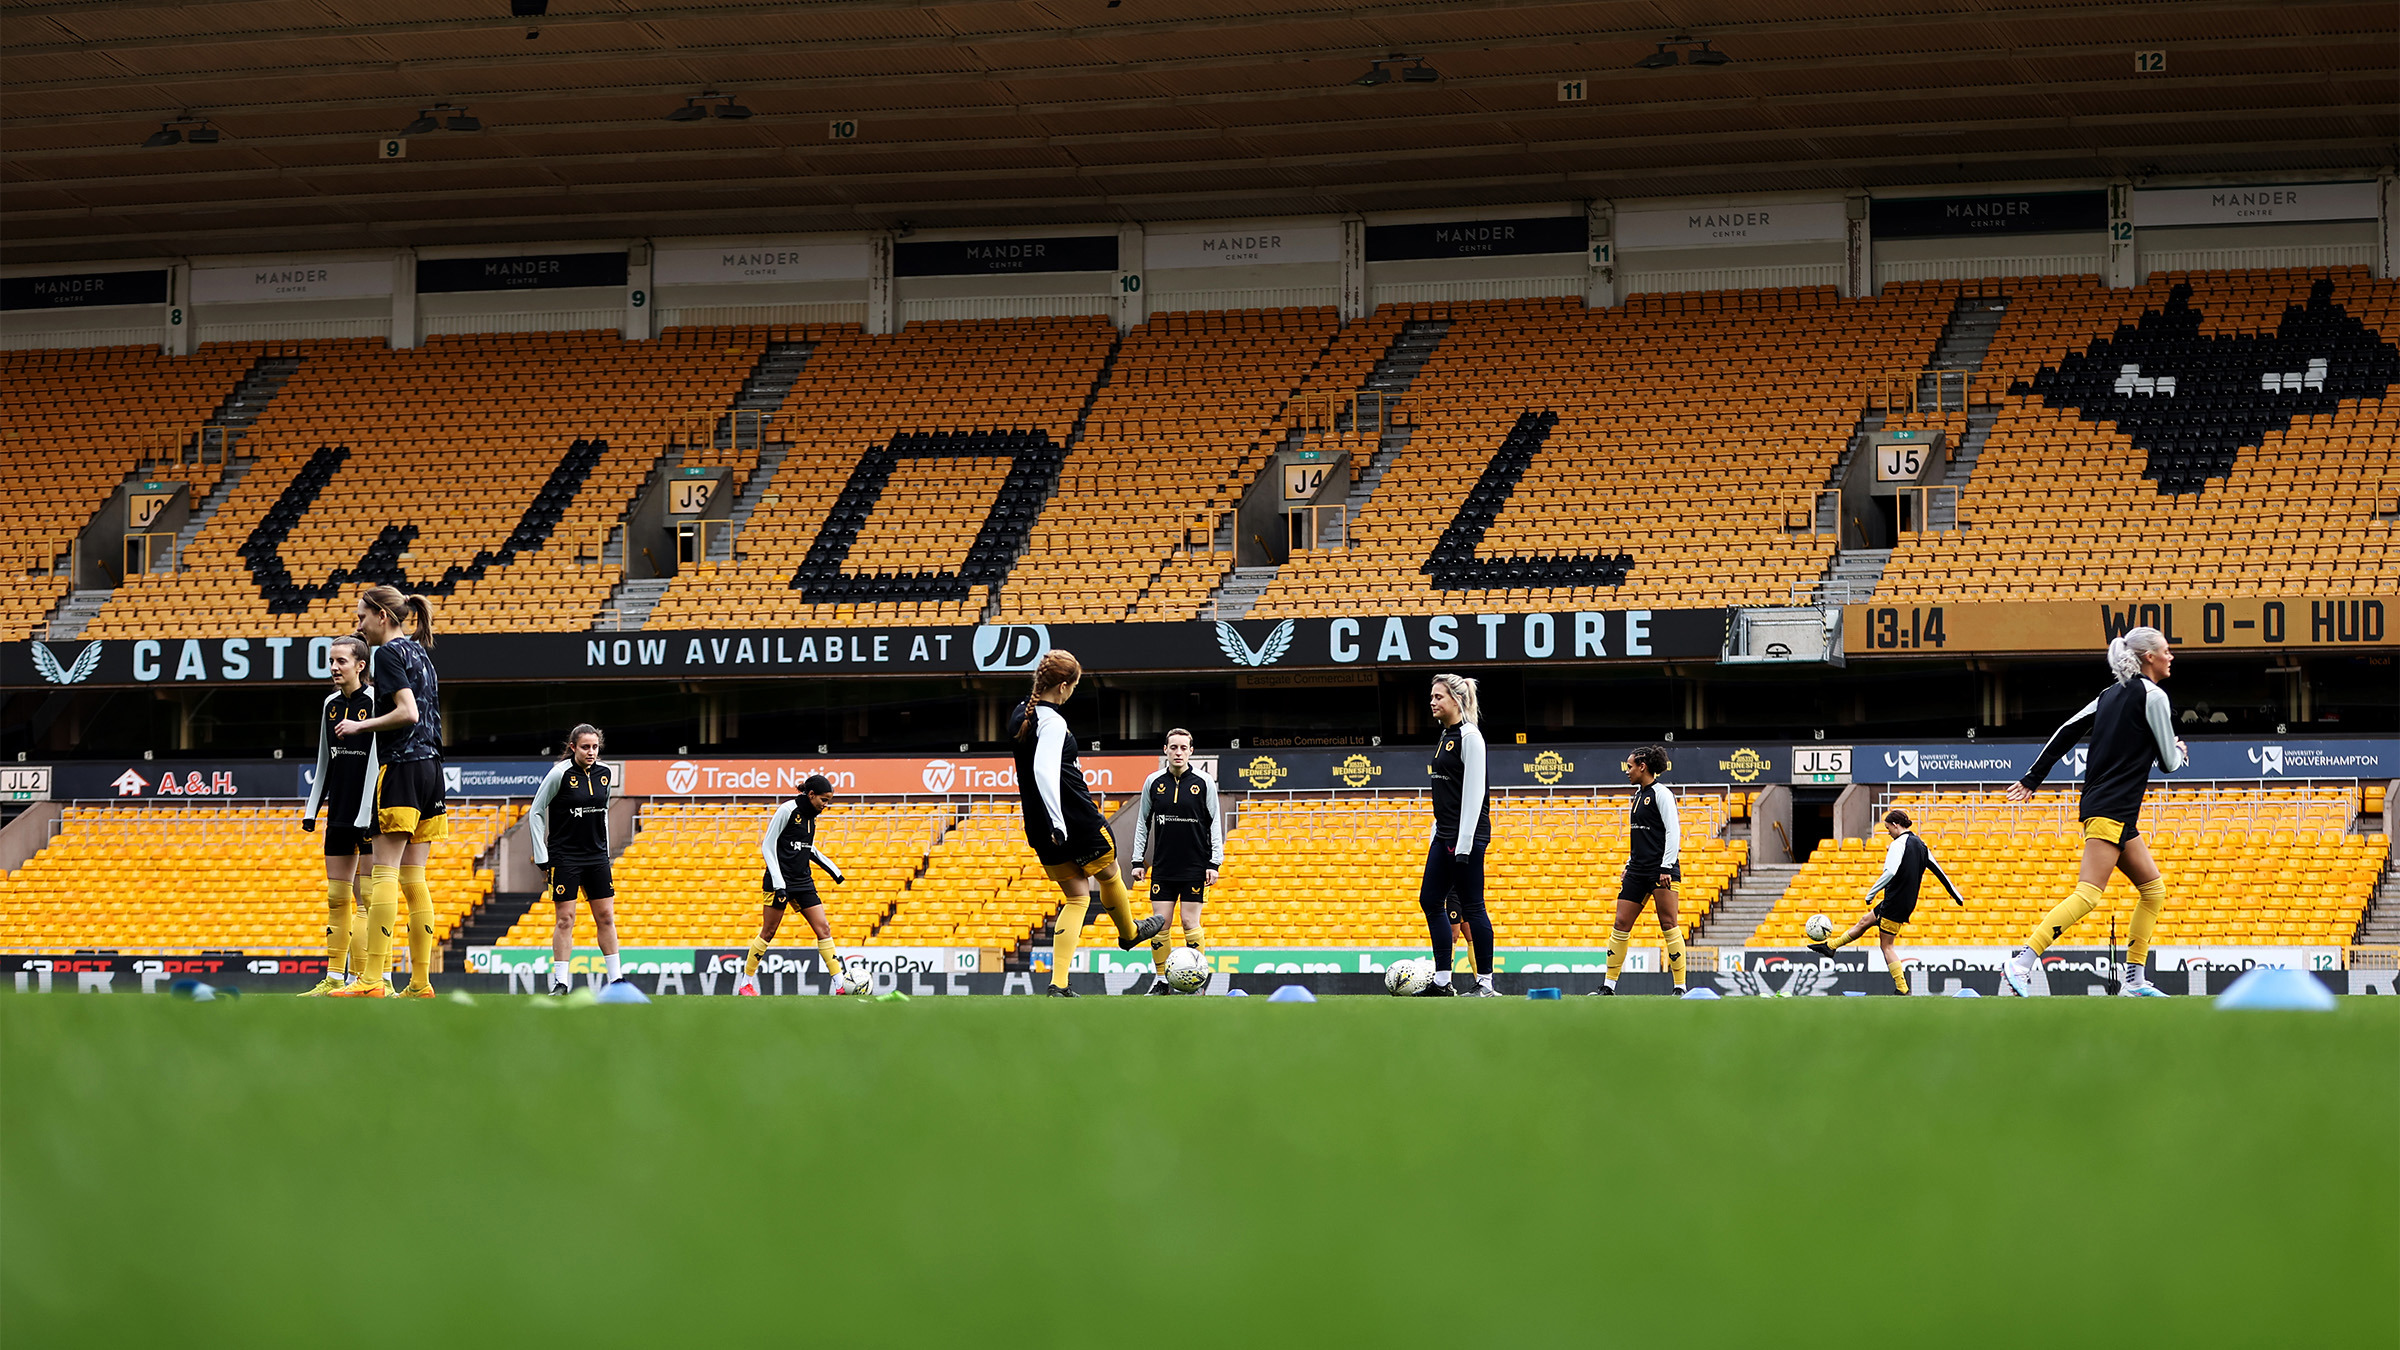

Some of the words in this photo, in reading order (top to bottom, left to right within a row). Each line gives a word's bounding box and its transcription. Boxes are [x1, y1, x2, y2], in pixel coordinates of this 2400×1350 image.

[2137, 53, 2164, 71] 12
[1562, 82, 1583, 99] 11
[830, 121, 856, 138] 10
[386, 140, 400, 158] 9
[2212, 191, 2297, 207] MANDER
[1946, 201, 2030, 217] MANDER
[2237, 208, 2273, 217] CENTRE
[1689, 212, 1770, 228] MANDER
[1970, 218, 2006, 228] CENTRE
[1436, 226, 1516, 242] MANDER
[1712, 229, 1747, 238] CENTRE
[2110, 221, 2133, 240] 12
[1203, 235, 1282, 251] MANDER
[1458, 243, 1492, 252] CENTRE
[722, 252, 800, 267] MANDER
[967, 244, 1046, 260] MANDER
[1225, 252, 1258, 261] CENTRE
[1593, 244, 1610, 261] 11
[485, 260, 560, 276] MANDER
[744, 268, 777, 276] CENTRE
[989, 261, 1023, 269] CENTRE
[255, 270, 328, 285] MANDER
[506, 277, 538, 285] CENTRE
[1120, 275, 1141, 292] 10
[35, 279, 105, 295] MANDER
[275, 285, 307, 293] CENTRE
[631, 290, 646, 307] 9
[171, 308, 182, 326] 8
[1888, 450, 1920, 475] J5
[1294, 469, 1323, 493] J4
[680, 484, 709, 508] J3
[1866, 607, 1946, 649] 13:14
[2101, 603, 2183, 645] WOL
[2311, 600, 2384, 642] HUD
[1329, 610, 1653, 663] CASTORE
[586, 638, 667, 666] NOW
[685, 635, 889, 664] AVAILABLE
[909, 634, 953, 662] AT
[133, 637, 376, 682] CASTO
[1246, 674, 1291, 686] Eastgate
[1293, 673, 1354, 684] Commercial
[1357, 673, 1374, 682] Ltd
[1253, 736, 1292, 747] Eastgate
[1293, 736, 1348, 746] Commercial
[1349, 736, 1365, 745] Ltd
[1523, 762, 1574, 773] WEDNESFIELD
[1719, 759, 1771, 771] WEDNESFIELD
[1803, 752, 1843, 771] JL5
[1920, 759, 2012, 770] WOLVERHAMPTON
[2284, 755, 2379, 766] WOLVERHAMPTON
[702, 766, 770, 788] Trade
[777, 766, 855, 788] Naon
[1238, 767, 1288, 778] WEDNESFIELD
[1332, 765, 1382, 776] WEDNESFIELD
[8, 772, 40, 790] JL2
[462, 775, 543, 785] WOLVERHAMPTON
[470, 953, 488, 967] 10
[491, 953, 694, 974] bet65com
[706, 954, 811, 973] AstoPay
[957, 954, 975, 968] 10
[1630, 955, 1644, 968] 11
[1723, 954, 1740, 969] 12
[1904, 958, 1998, 971] stroPay
[2312, 954, 2333, 970] 12
